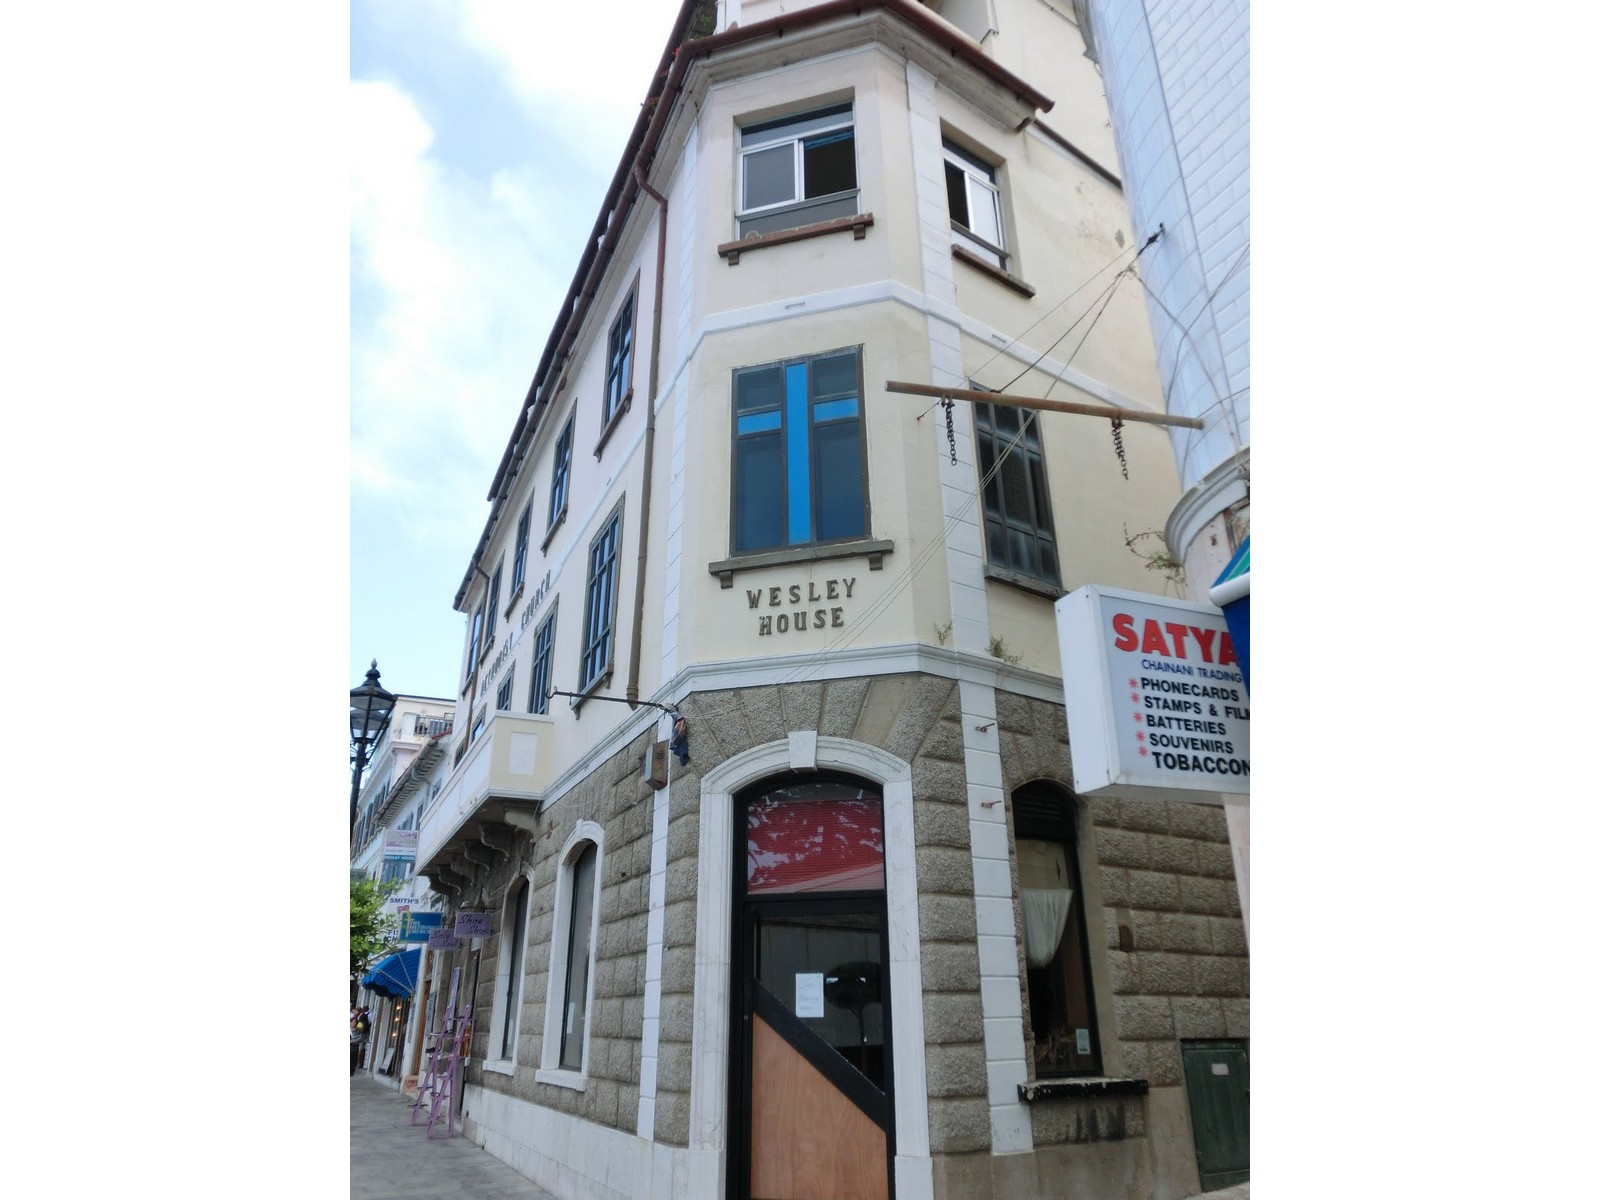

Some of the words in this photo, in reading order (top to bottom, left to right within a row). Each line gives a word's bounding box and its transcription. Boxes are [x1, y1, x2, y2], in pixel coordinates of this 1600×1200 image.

[746, 577, 856, 609] WESLEY
[759, 606, 844, 636] HOUSE
[1112, 613, 1240, 667] SATYA
[1141, 659, 1194, 677] CHAINANI
[1197, 667, 1243, 683] TRADING
[1140, 677, 1240, 702] PHONECARDS
[1144, 695, 1202, 715] STAMPS
[1209, 704, 1219, 717] &
[1146, 714, 1227, 735] BATTERIES
[1149, 733, 1235, 754] SOUVENIRS
[458, 914, 484, 925] Shoe
